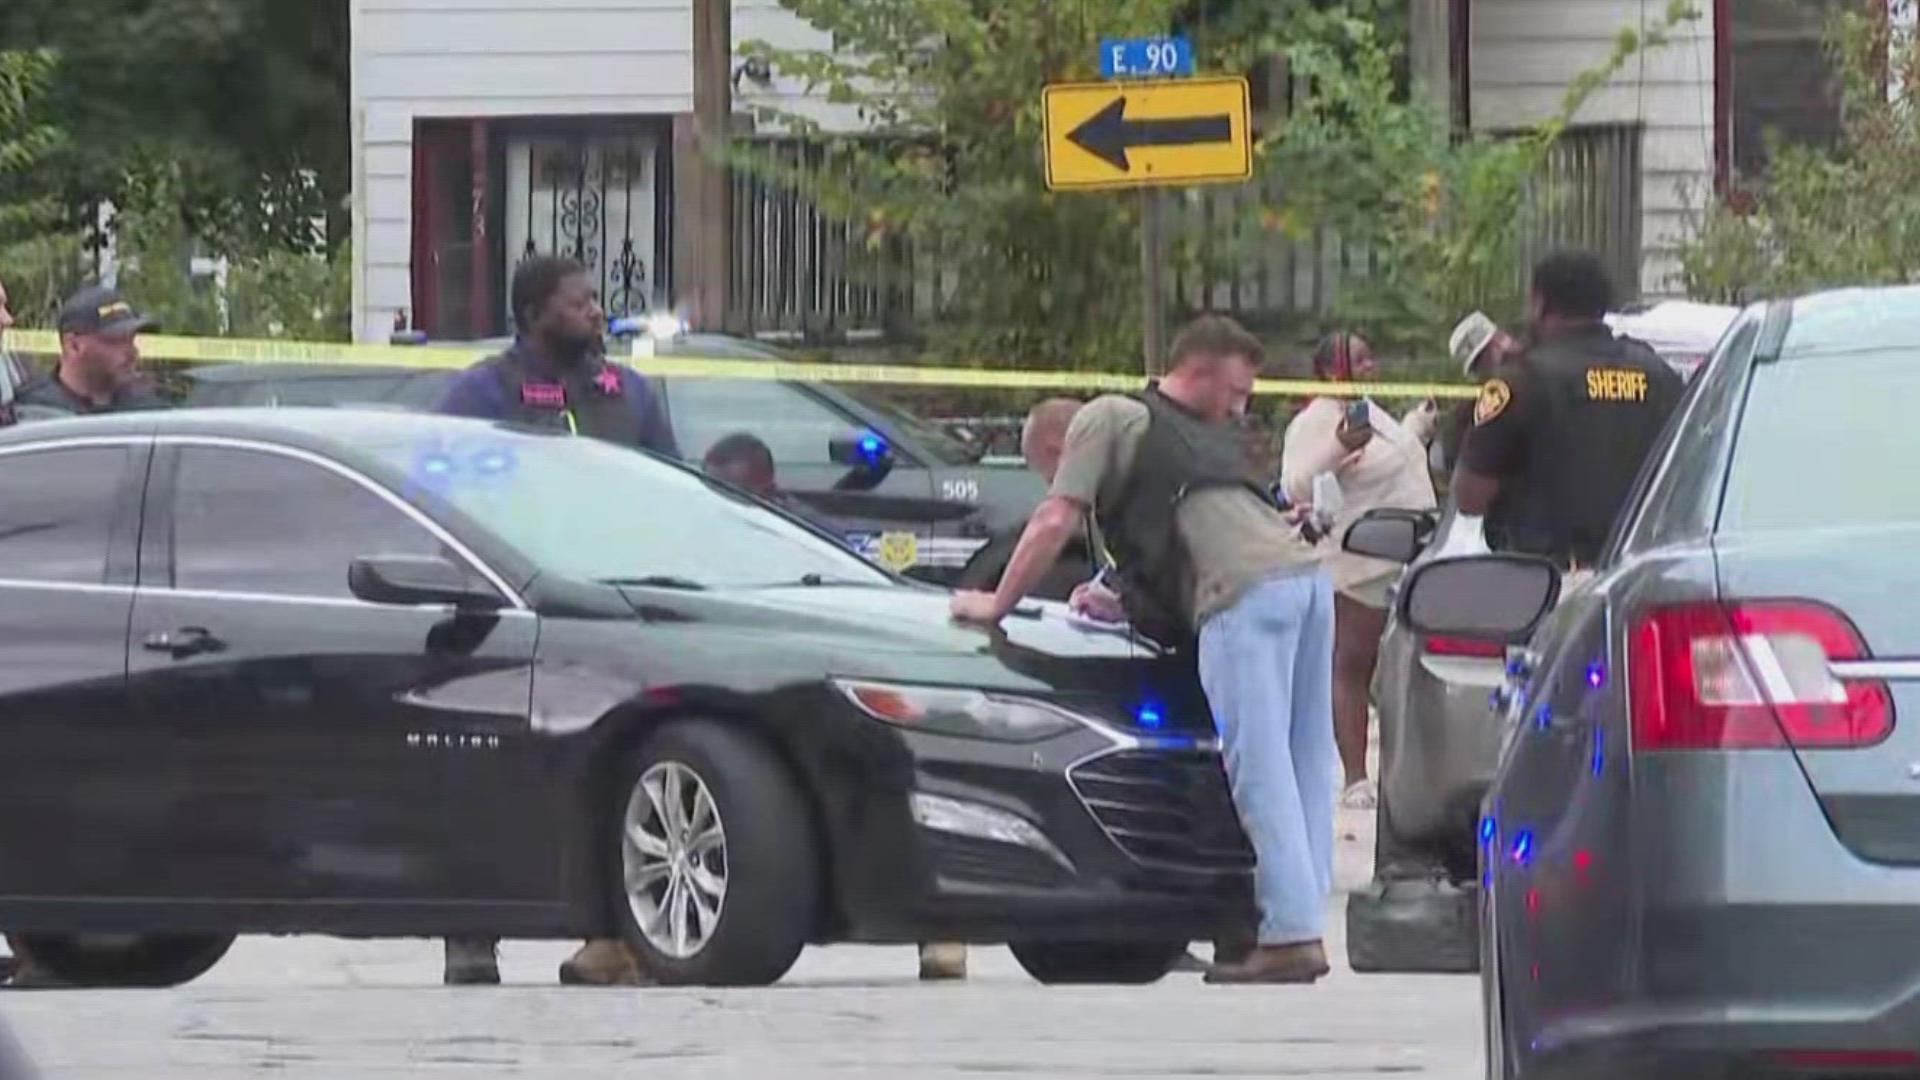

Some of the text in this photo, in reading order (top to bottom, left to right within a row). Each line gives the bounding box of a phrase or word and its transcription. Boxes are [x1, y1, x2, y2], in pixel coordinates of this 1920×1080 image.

[1112, 43, 1178, 73] E. 90
[1586, 368, 1647, 402] SHERIFF
[943, 480, 978, 501] 505
[407, 733, 499, 748] MALIBU
